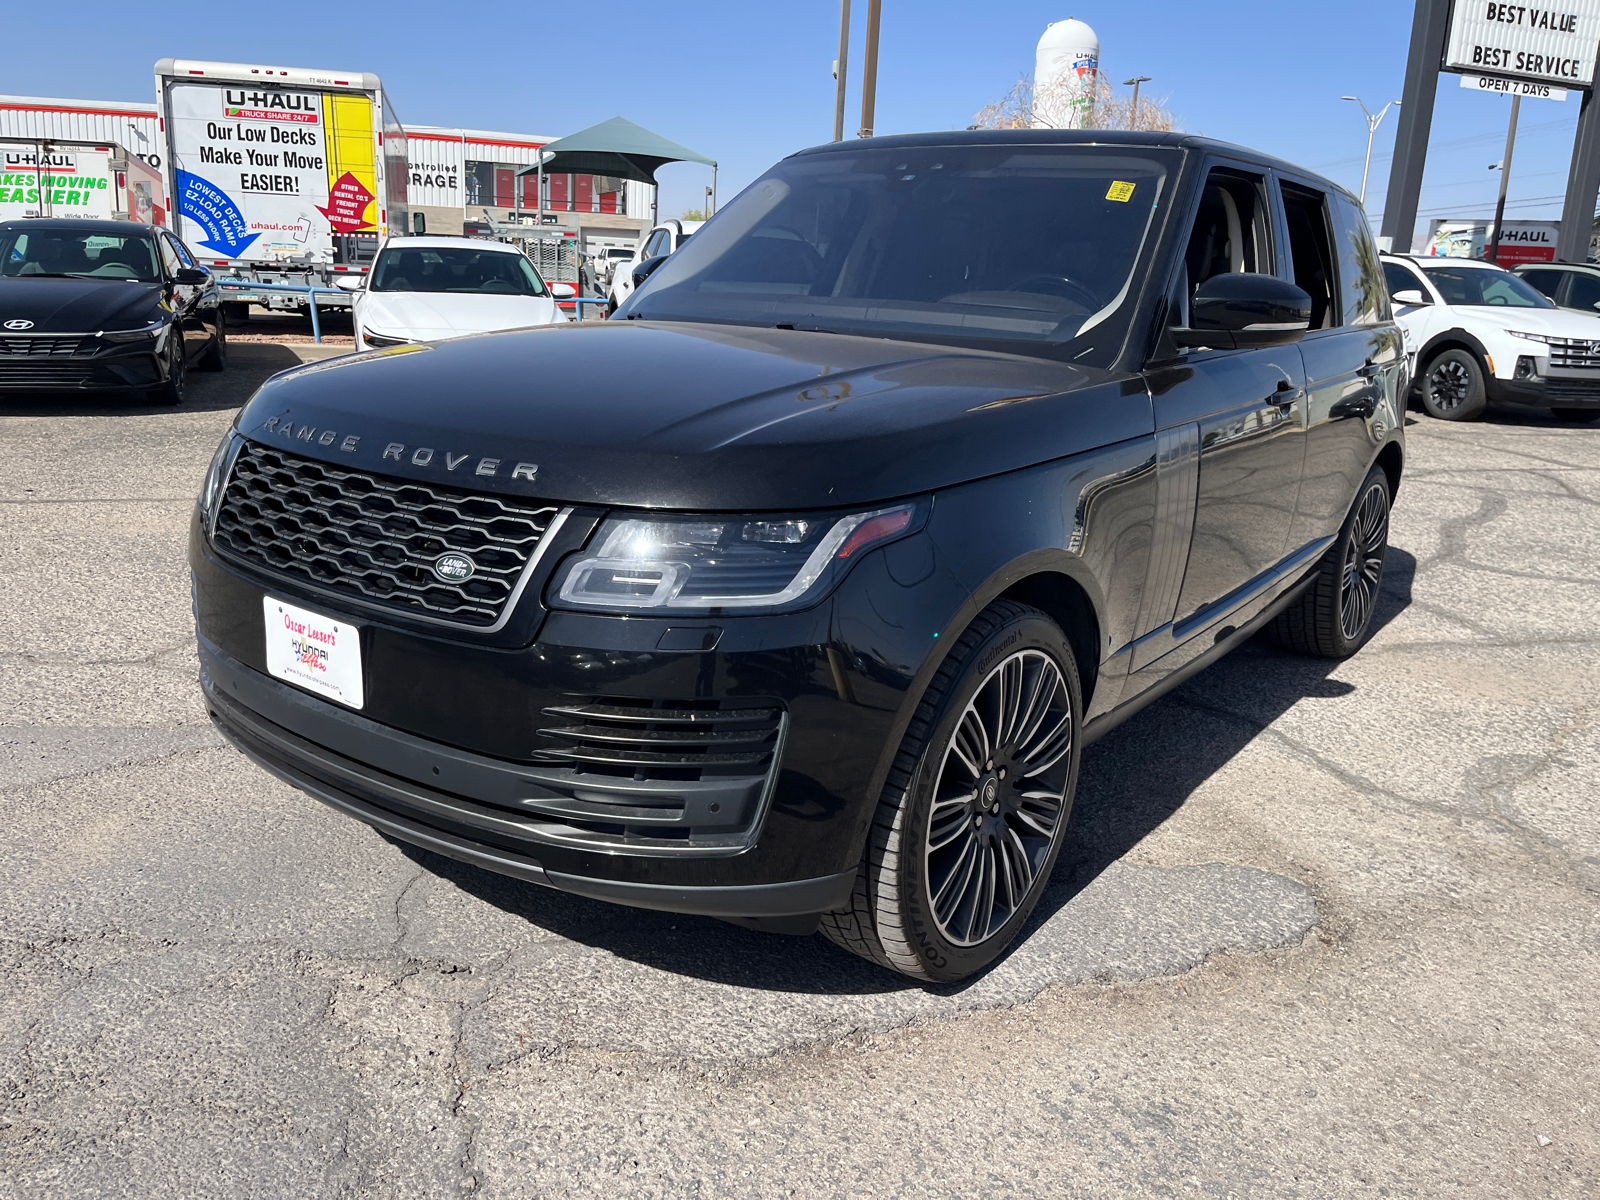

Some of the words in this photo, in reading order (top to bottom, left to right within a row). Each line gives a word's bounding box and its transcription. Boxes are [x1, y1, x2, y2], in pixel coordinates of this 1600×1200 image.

[1486, 2, 1526, 25] BEST
[1530, 8, 1577, 33] VALUE
[1472, 45, 1511, 67] BEST
[1515, 51, 1580, 77] SERVICE
[1479, 77, 1510, 91] OPEN
[1513, 82, 1520, 93] 7
[1522, 83, 1550, 97] DAYS
[226, 90, 316, 111] U-HAUL
[240, 110, 265, 118] TRUCK
[267, 112, 291, 120] SHARE
[207, 122, 232, 141] Our
[237, 124, 266, 142] Low
[270, 126, 317, 146] Decks
[6, 153, 74, 166] U-HAUL
[200, 146, 242, 165] Make
[246, 149, 279, 167] Your
[283, 151, 323, 170] Move
[408, 163, 457, 173] ontrolled
[41, 175, 108, 189] MOVING
[240, 173, 299, 192] EASIER!
[341, 184, 358, 192] OTHER
[407, 173, 457, 189] RAGE
[334, 191, 354, 199] RENTAL
[336, 200, 358, 208] FREIGHT
[189, 179, 226, 207] LOWEST
[224, 207, 247, 238] DECKS
[336, 208, 354, 216] TRUCK
[184, 202, 194, 211] 1/3
[193, 208, 210, 222] LESS
[207, 221, 221, 242] WORK
[185, 190, 222, 219] EZ-LOAD
[219, 219, 237, 247] RAMP
[251, 222, 303, 231] uhaul.com
[328, 214, 341, 222] DECK
[342, 217, 360, 225] HEIGHT
[263, 415, 361, 452] RANGE
[382, 442, 540, 482] ROVER
[441, 566, 467, 577] ROVER
[442, 558, 464, 568] LAND
[284, 613, 306, 635] Oscar
[307, 623, 336, 647] Leeser's
[291, 638, 329, 661] HYUNDAI
[977, 631, 1018, 675] Continental
